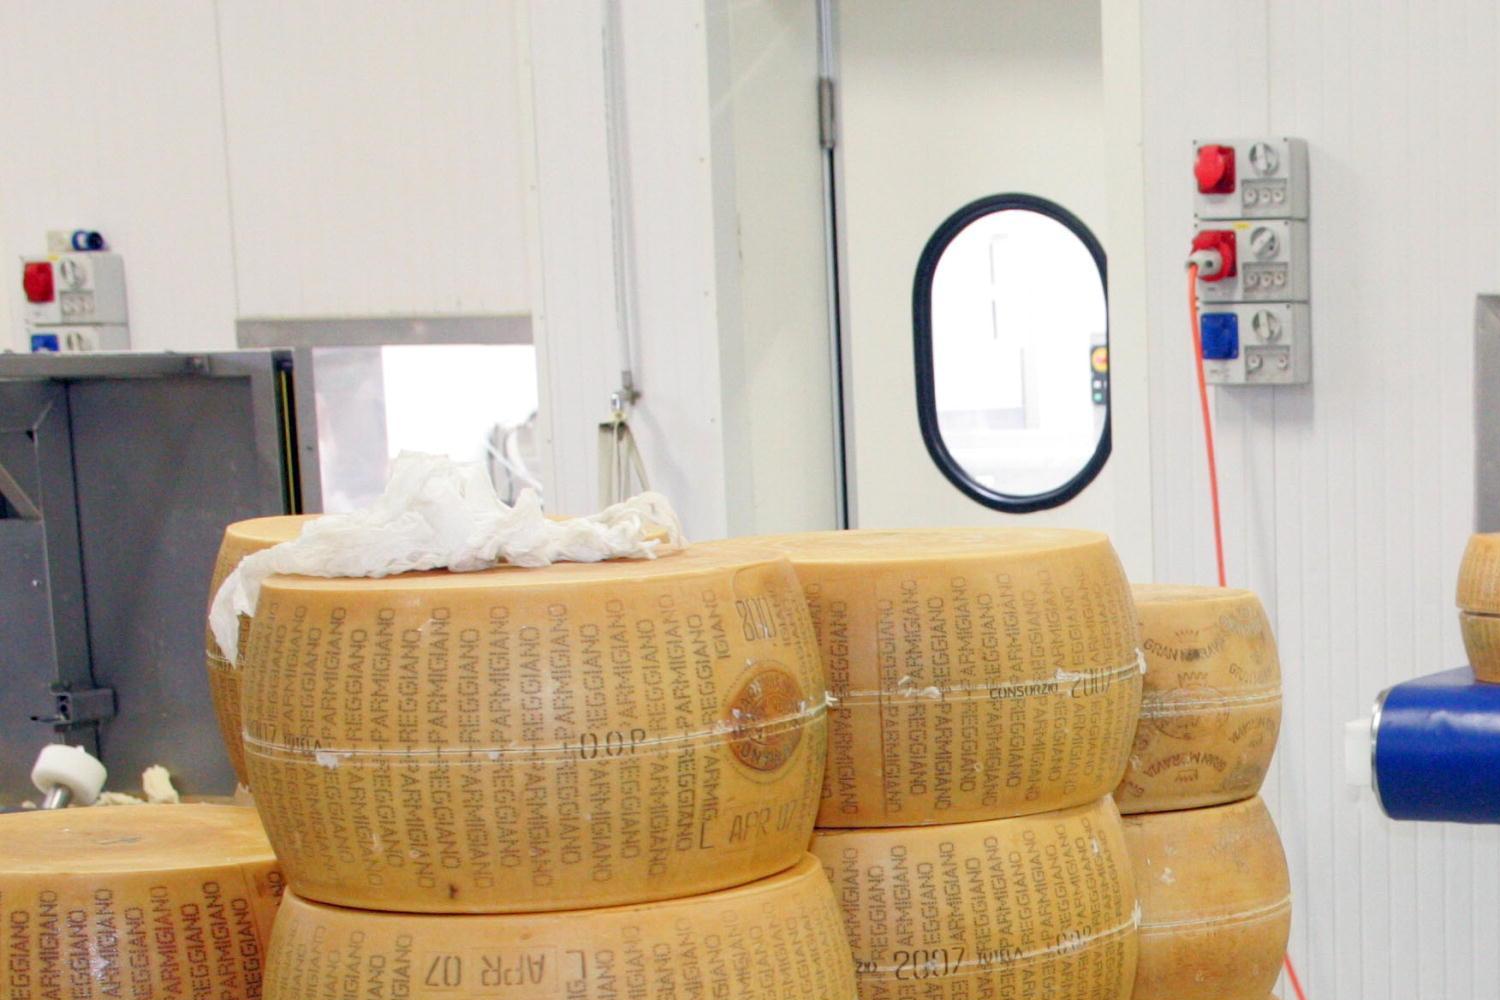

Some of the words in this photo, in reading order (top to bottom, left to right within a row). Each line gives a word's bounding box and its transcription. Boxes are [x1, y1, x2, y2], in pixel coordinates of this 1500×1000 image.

[989, 683, 1058, 700] CONSORZIO
[729, 808, 770, 843] APR
[425, 955, 462, 986] 07
[481, 953, 545, 985] APR
